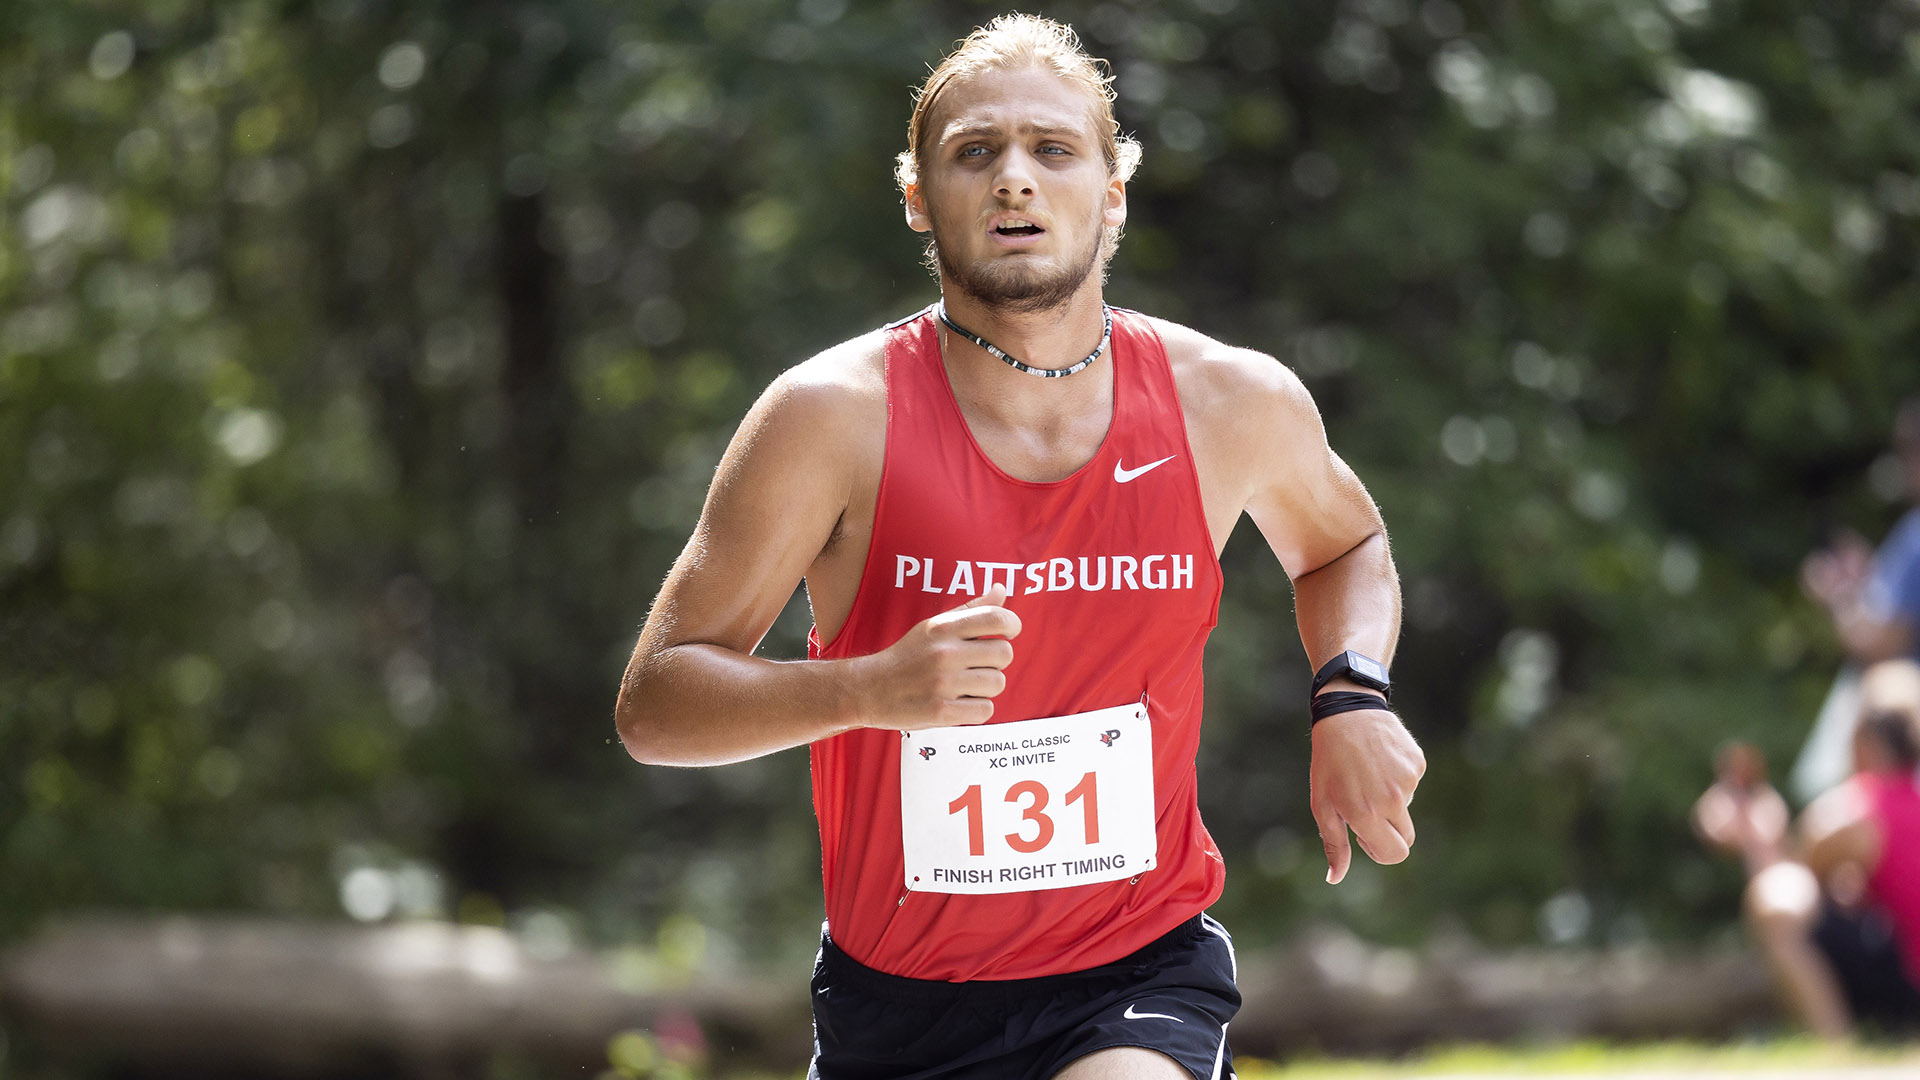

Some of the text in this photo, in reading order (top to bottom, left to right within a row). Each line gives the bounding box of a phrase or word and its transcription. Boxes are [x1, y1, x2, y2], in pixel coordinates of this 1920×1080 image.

[894, 554, 1194, 597] PLATTSBURGH
[958, 734, 1071, 754] CARDINAL CLASSIC
[989, 752, 1056, 769] XC INVITE
[949, 771, 1100, 856] 131
[933, 854, 1125, 883] FINISH RIGHT TIMING
